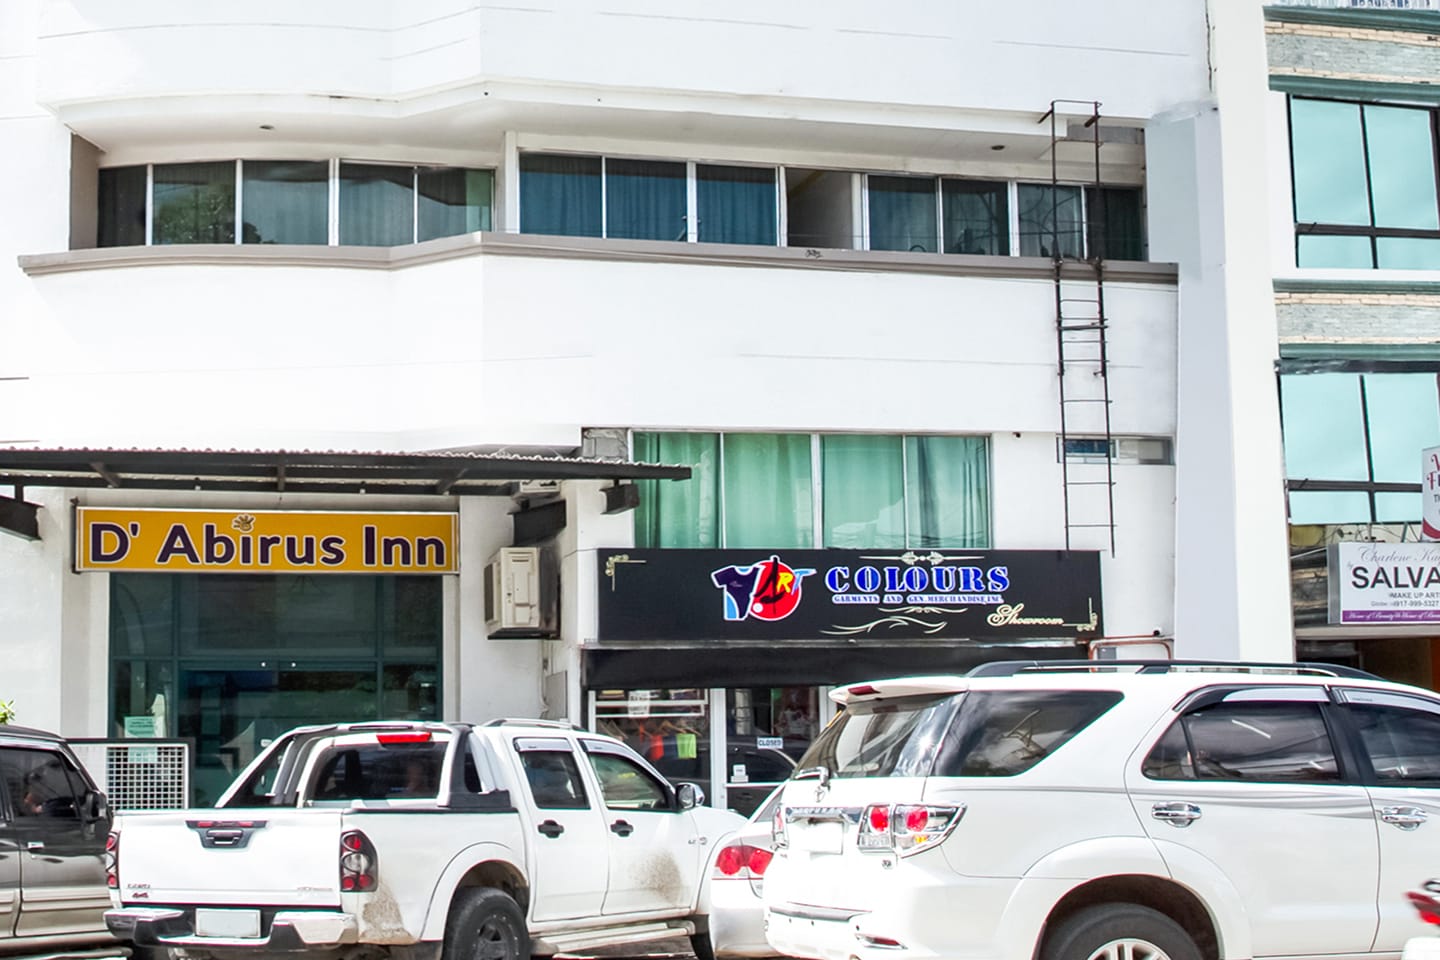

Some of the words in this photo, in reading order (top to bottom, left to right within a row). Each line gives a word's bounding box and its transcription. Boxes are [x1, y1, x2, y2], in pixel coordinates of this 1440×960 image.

[89, 522, 139, 563] D'
[156, 522, 345, 564] Abirus
[362, 525, 446, 565] Inn
[825, 566, 1010, 593] COLOURS
[987, 603, 1064, 626] Showroom
